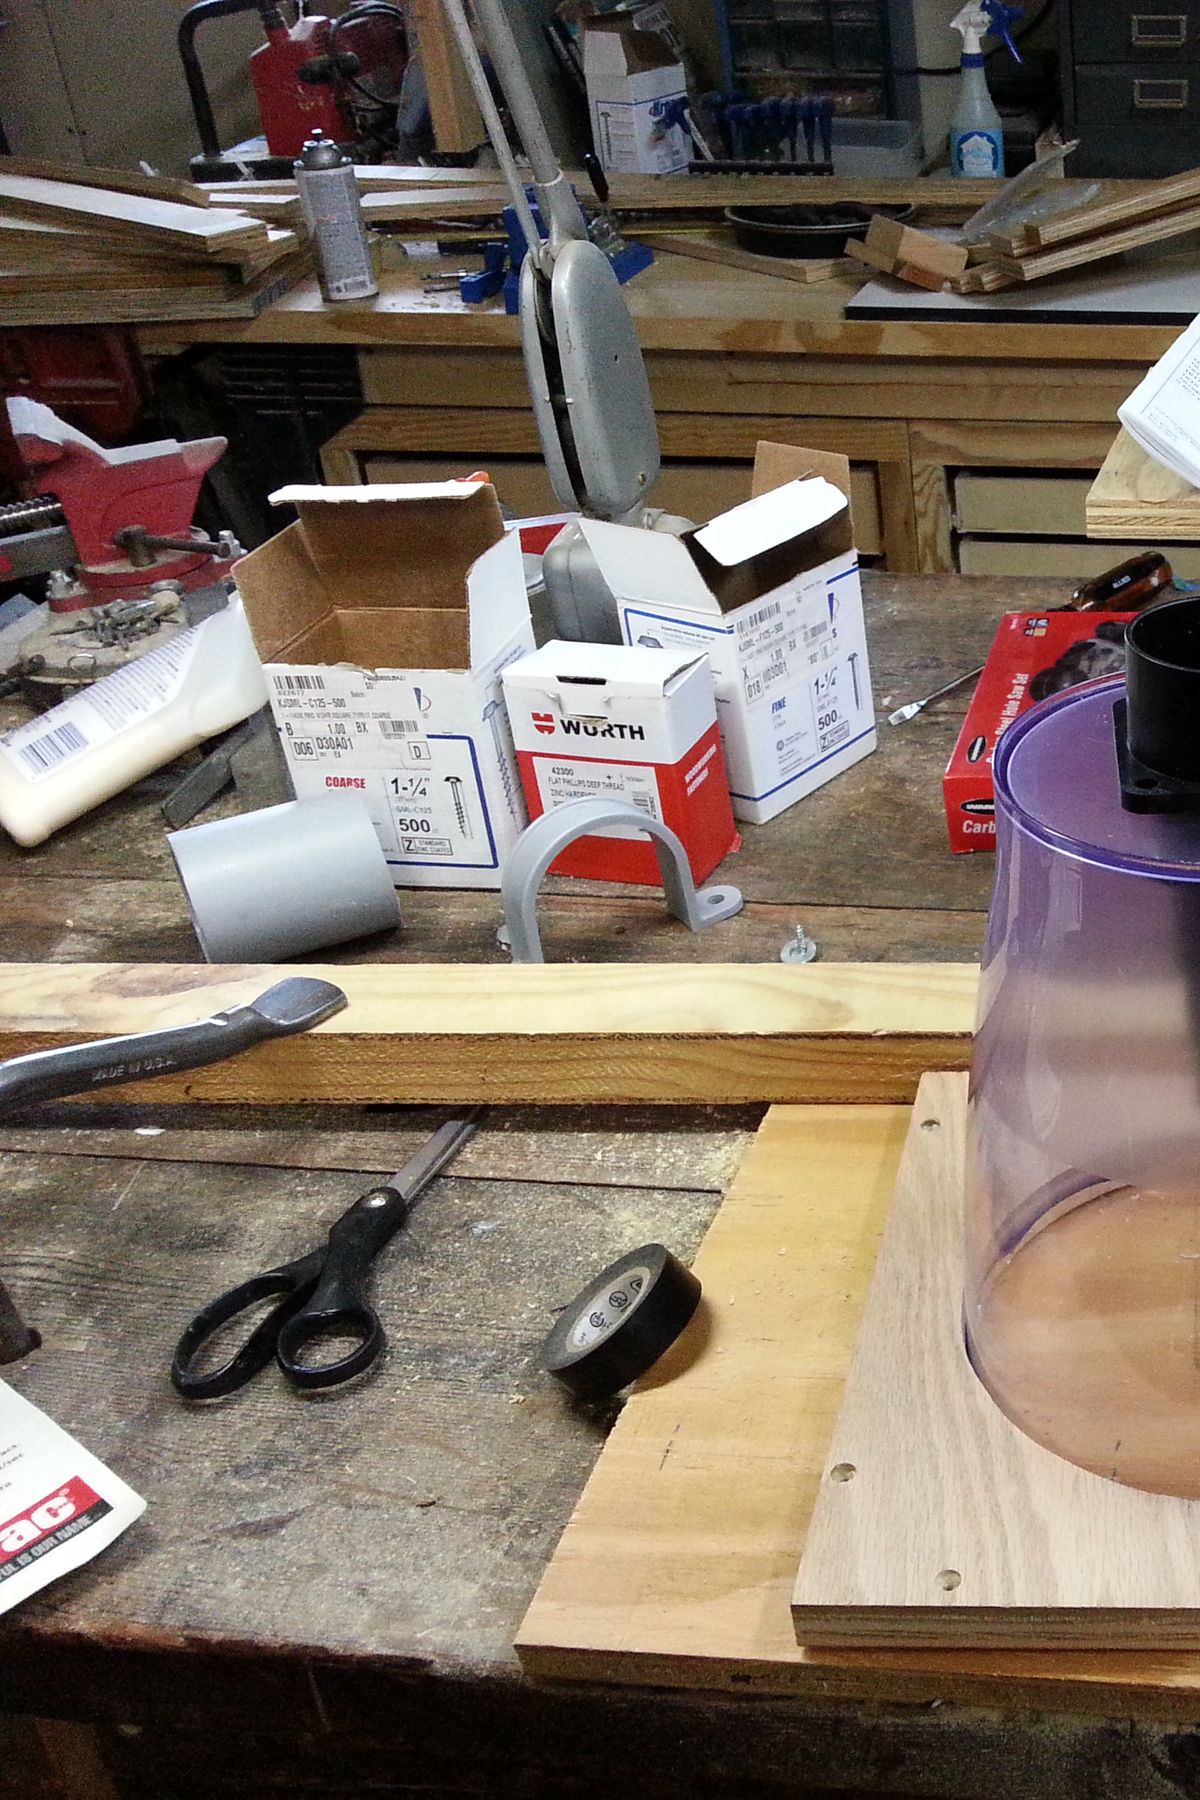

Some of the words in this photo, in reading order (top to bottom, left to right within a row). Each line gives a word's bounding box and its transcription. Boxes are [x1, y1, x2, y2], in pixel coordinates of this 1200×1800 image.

[772, 696, 786, 714] FINE
[818, 709, 838, 731] 500
[284, 721, 294, 736] B
[327, 722, 346, 735] 1.00
[355, 721, 369, 733] BX
[293, 741, 314, 756] 006
[316, 736, 354, 751] D30A01
[412, 745, 422, 759] D
[325, 776, 366, 789] COARSE
[399, 818, 431, 833] 500
[404, 839, 415, 852] Z
[30, 1536, 58, 1558] OUR
